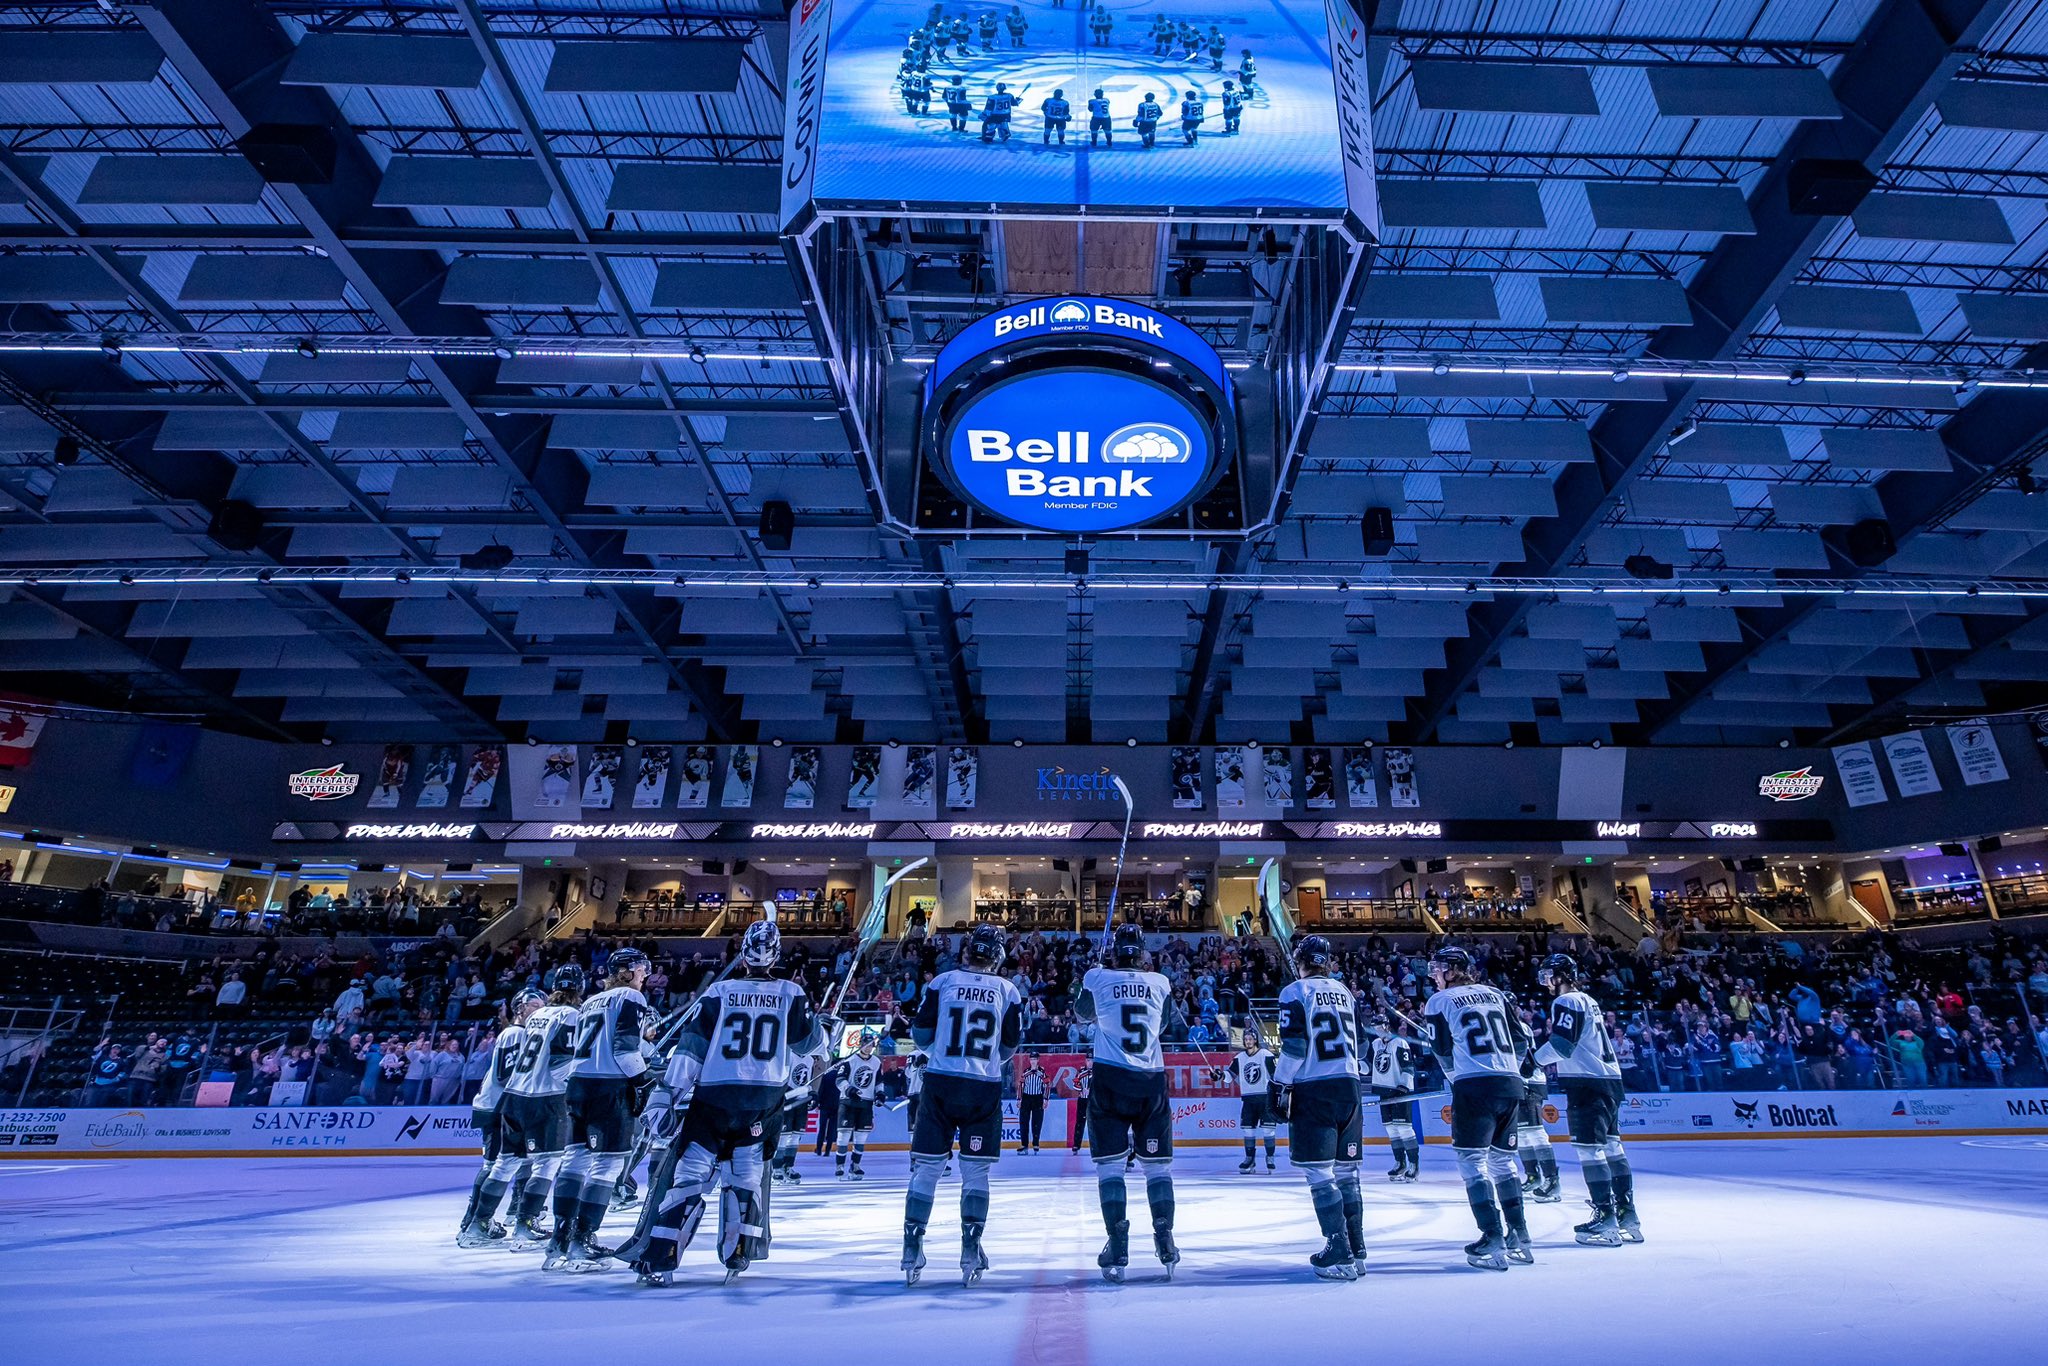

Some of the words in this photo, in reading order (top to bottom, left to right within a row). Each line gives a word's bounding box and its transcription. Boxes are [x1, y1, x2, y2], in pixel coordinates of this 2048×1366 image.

[787, 34, 819, 189] Corwin
[1337, 42, 1363, 170] WEYER
[995, 306, 1045, 337] Bell
[1094, 305, 1164, 338] Bank
[967, 429, 1090, 463] Bell
[1005, 468, 1154, 497] Bank
[1044, 502, 1088, 510] Member
[1091, 502, 1118, 510] FDIC
[292, 776, 356, 784] INTERSTATE
[1036, 768, 1120, 790] Kinetic
[1038, 791, 1120, 800] LEASING
[345, 824, 403, 838] FORCE
[550, 824, 606, 838] FORCE
[751, 824, 806, 838] FORCE
[949, 824, 1003, 837] FORCE
[1143, 823, 1195, 837] FORCE
[1334, 823, 1387, 836] FORCE
[977, 944, 985, 953] 12
[1128, 947, 1133, 955] 5
[957, 987, 995, 1003] PARKS
[1113, 985, 1152, 999] GRUBA
[1315, 992, 1348, 1007] BOSER
[728, 993, 783, 1009] SLUKYNSKY
[1280, 1009, 1291, 1028] 5
[1556, 1012, 1574, 1030] 19
[721, 1011, 780, 1060] 30
[945, 1006, 997, 1061] 12
[1120, 1003, 1148, 1054] 5
[1311, 1011, 1357, 1062] 25
[1427, 1023, 1436, 1041] 0
[1461, 1010, 1513, 1055] 20
[252, 1111, 375, 1130] SANFORD
[433, 1118, 472, 1129] NETW
[1198, 1120, 1205, 1128] &
[1208, 1119, 1236, 1128] SONS
[1768, 1104, 1838, 1127] Bobcat
[84, 1123, 149, 1139] EideBailly
[175, 1128, 202, 1136] BUSINESS
[202, 1128, 231, 1136] ADVISORS
[271, 1135, 346, 1145] HEALTH
